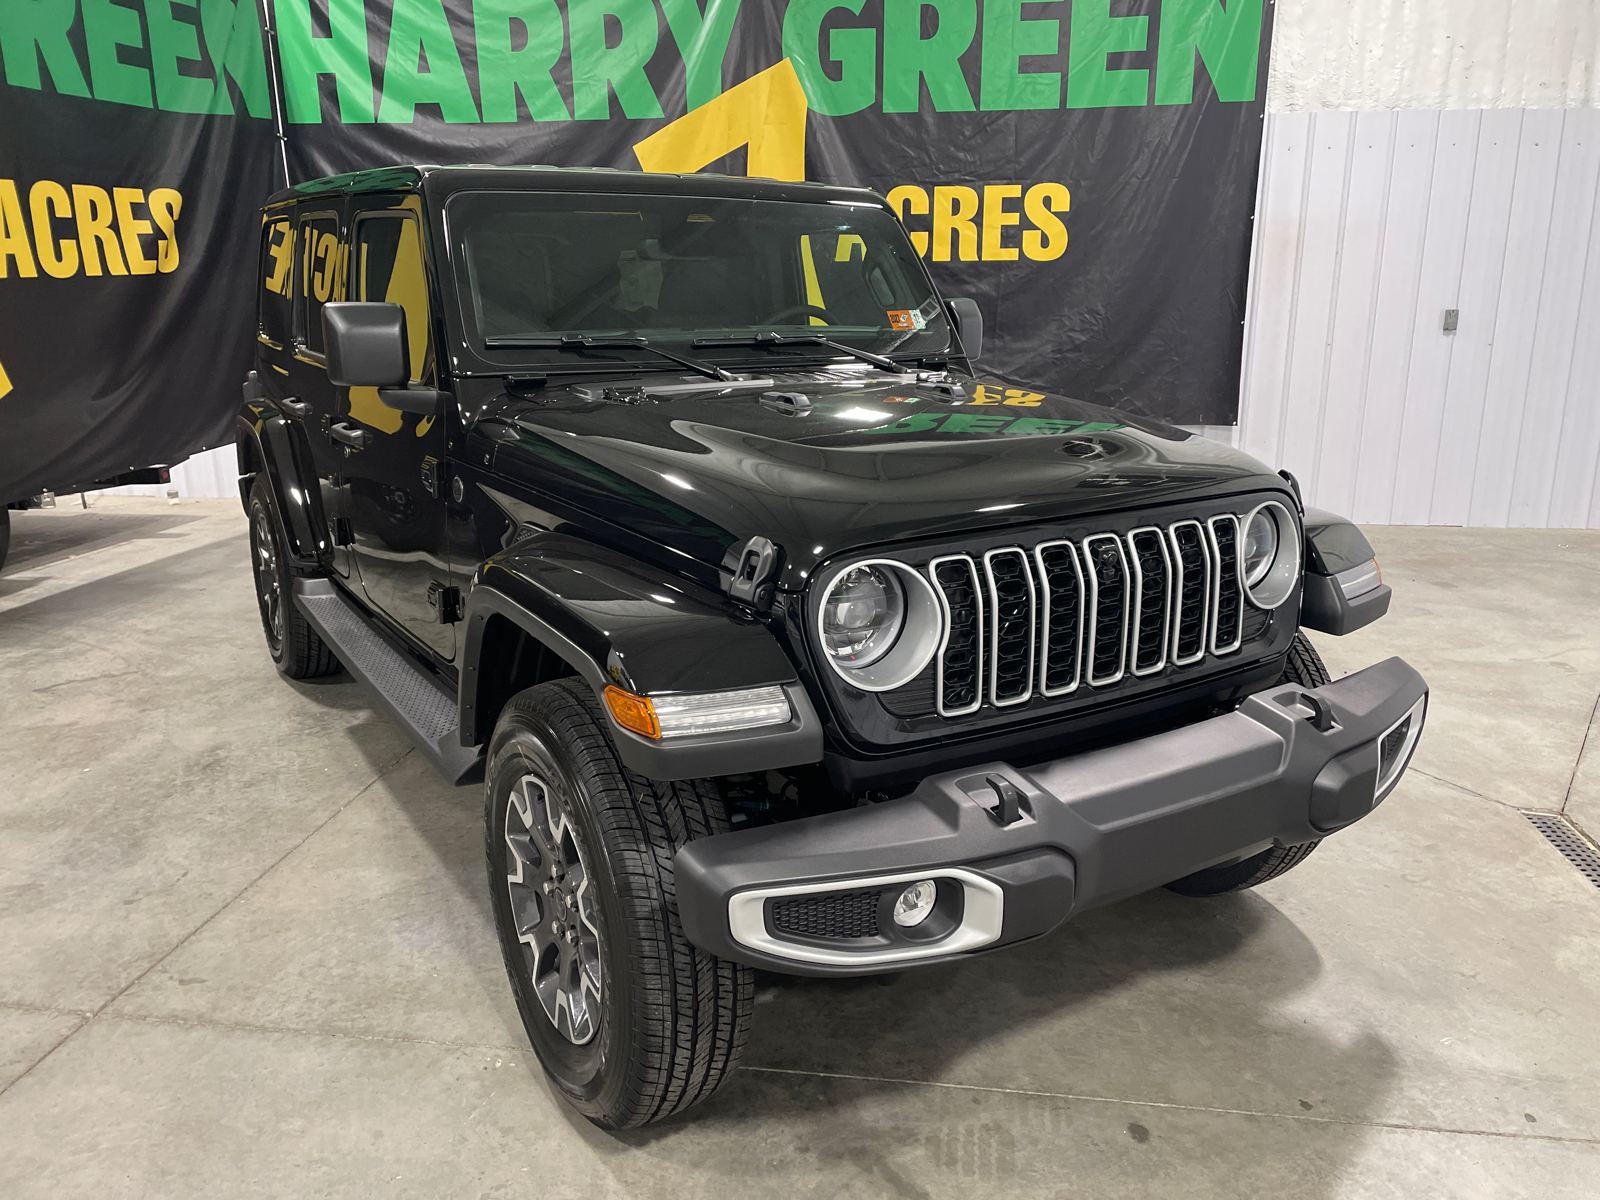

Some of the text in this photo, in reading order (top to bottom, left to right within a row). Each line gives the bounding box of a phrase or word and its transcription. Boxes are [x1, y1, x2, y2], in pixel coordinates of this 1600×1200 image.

[274, 0, 1262, 124] HARRY GREEN
[0, 179, 183, 278] ACRES
[884, 183, 1070, 262] CRES
